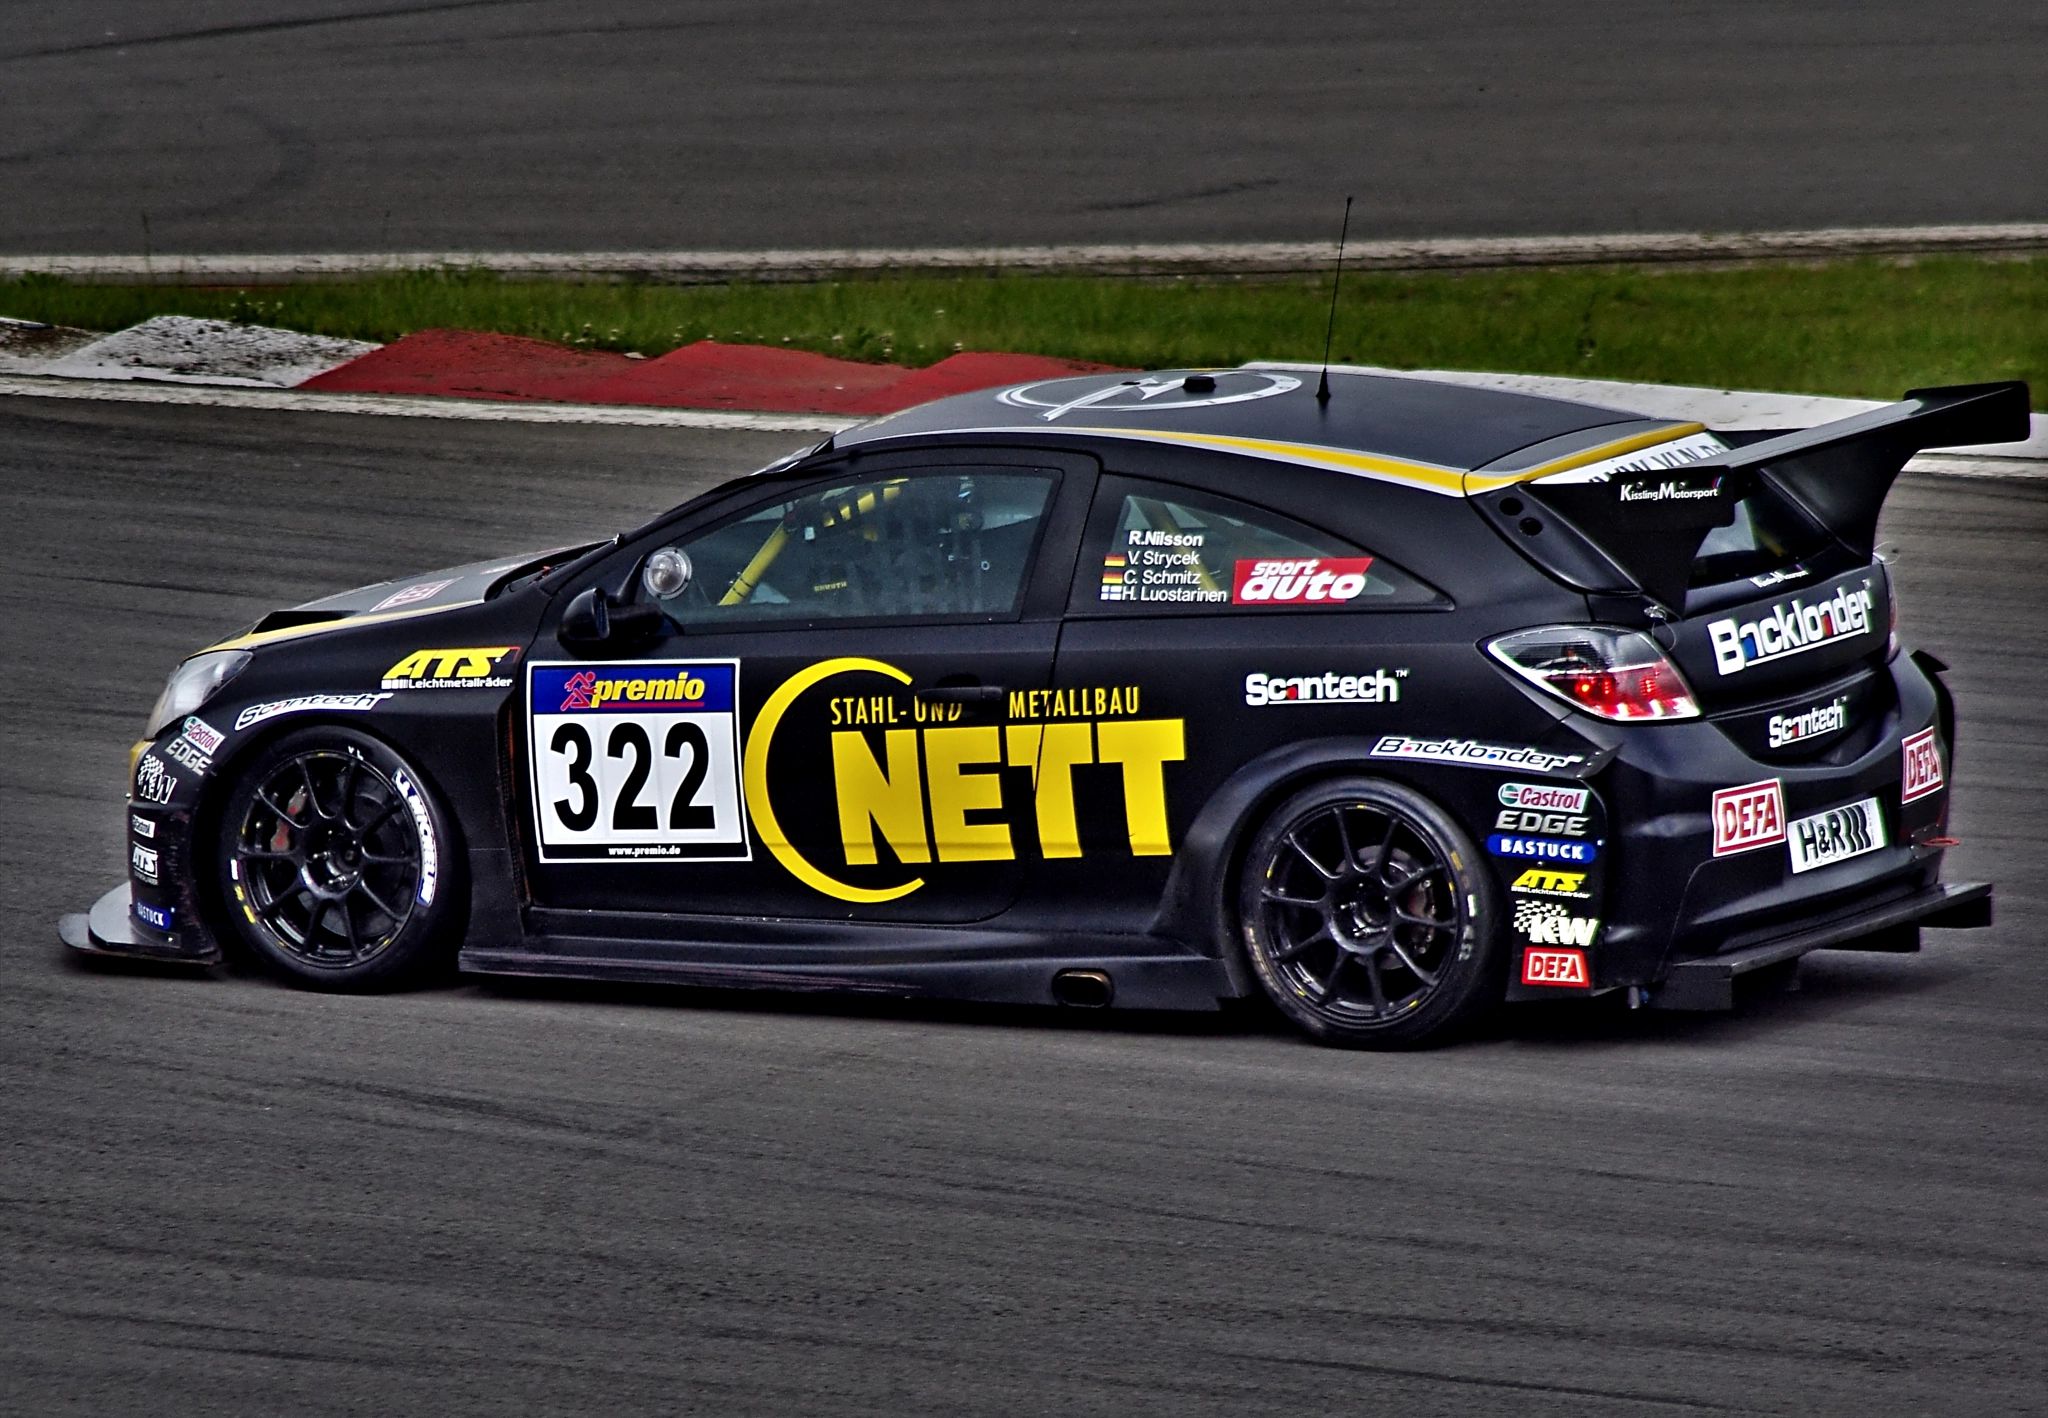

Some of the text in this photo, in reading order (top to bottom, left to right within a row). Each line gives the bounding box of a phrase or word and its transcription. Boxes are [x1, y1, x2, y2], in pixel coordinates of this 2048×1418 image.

[1128, 531, 1202, 547] R.Nilsson
[1127, 552, 1199, 568] V. Strycek
[1251, 560, 1319, 576] sport
[1123, 570, 1201, 585] C. Schmitz
[1240, 573, 1366, 600] auto
[1121, 588, 1226, 602] H. Luostarinen
[382, 648, 510, 679] ATS
[409, 678, 513, 689] Leichtmetallräder
[589, 671, 705, 708] premio
[1246, 670, 1397, 706] Scantech
[238, 693, 380, 726] Scantech
[831, 697, 906, 724] STAHL-
[1009, 687, 1139, 719] METALLBAU
[187, 723, 219, 751] Castrol
[1769, 699, 1843, 748] Scantech
[165, 738, 213, 776] EDGE
[1908, 744, 1938, 788] DEFA
[551, 722, 716, 832] 322
[1520, 787, 1581, 810] Castrol
[1495, 810, 1591, 836] EDGE
[1722, 794, 1777, 841] DEFA
[608, 846, 681, 857] www.premio.de
[1500, 838, 1584, 860] BASTUCK
[1511, 869, 1585, 892] ATS
[1529, 914, 1598, 946] KW
[1530, 955, 1579, 979] DEFA
